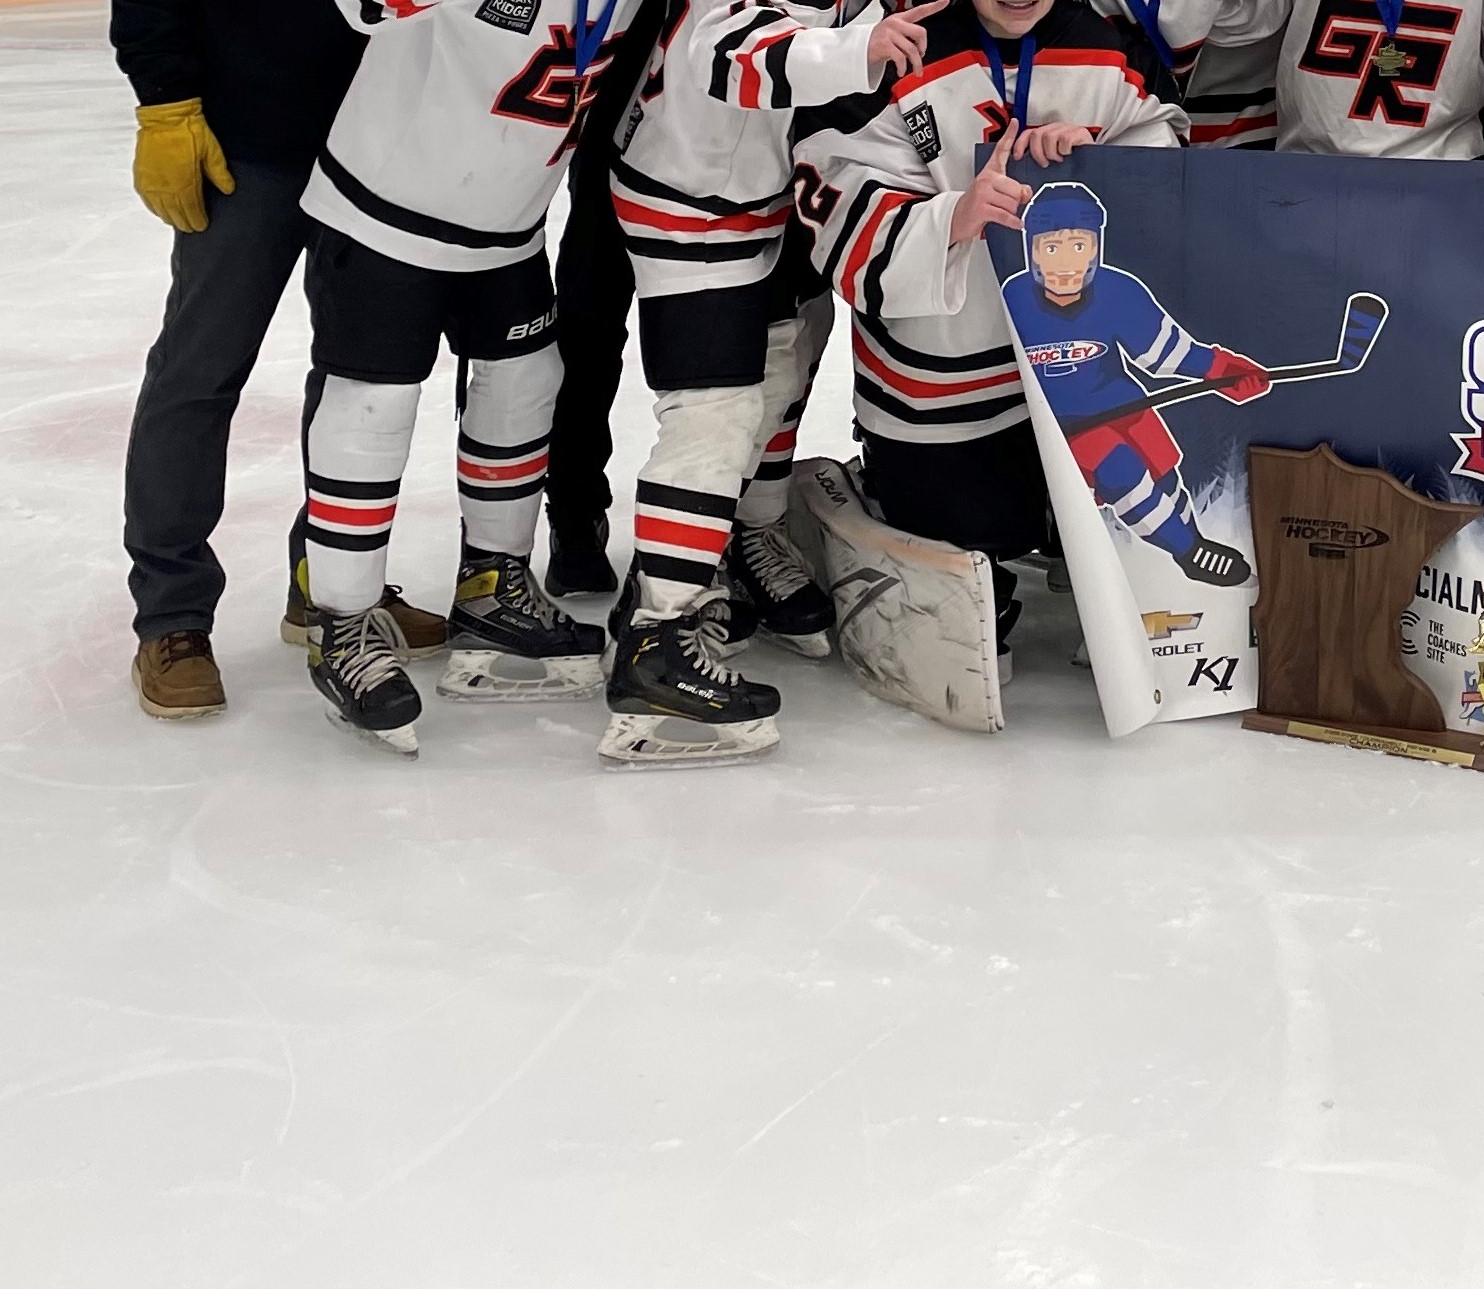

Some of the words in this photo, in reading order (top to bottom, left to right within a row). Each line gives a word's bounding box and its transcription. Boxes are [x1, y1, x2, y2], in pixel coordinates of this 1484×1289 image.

[1281, 517, 1348, 529] MINNESOTA
[1286, 525, 1372, 544] HOCKEY
[1429, 620, 1444, 634] THE
[1152, 642, 1204, 656] ROLET
[1427, 634, 1467, 657] COACHES
[1427, 647, 1445, 664] SITE
